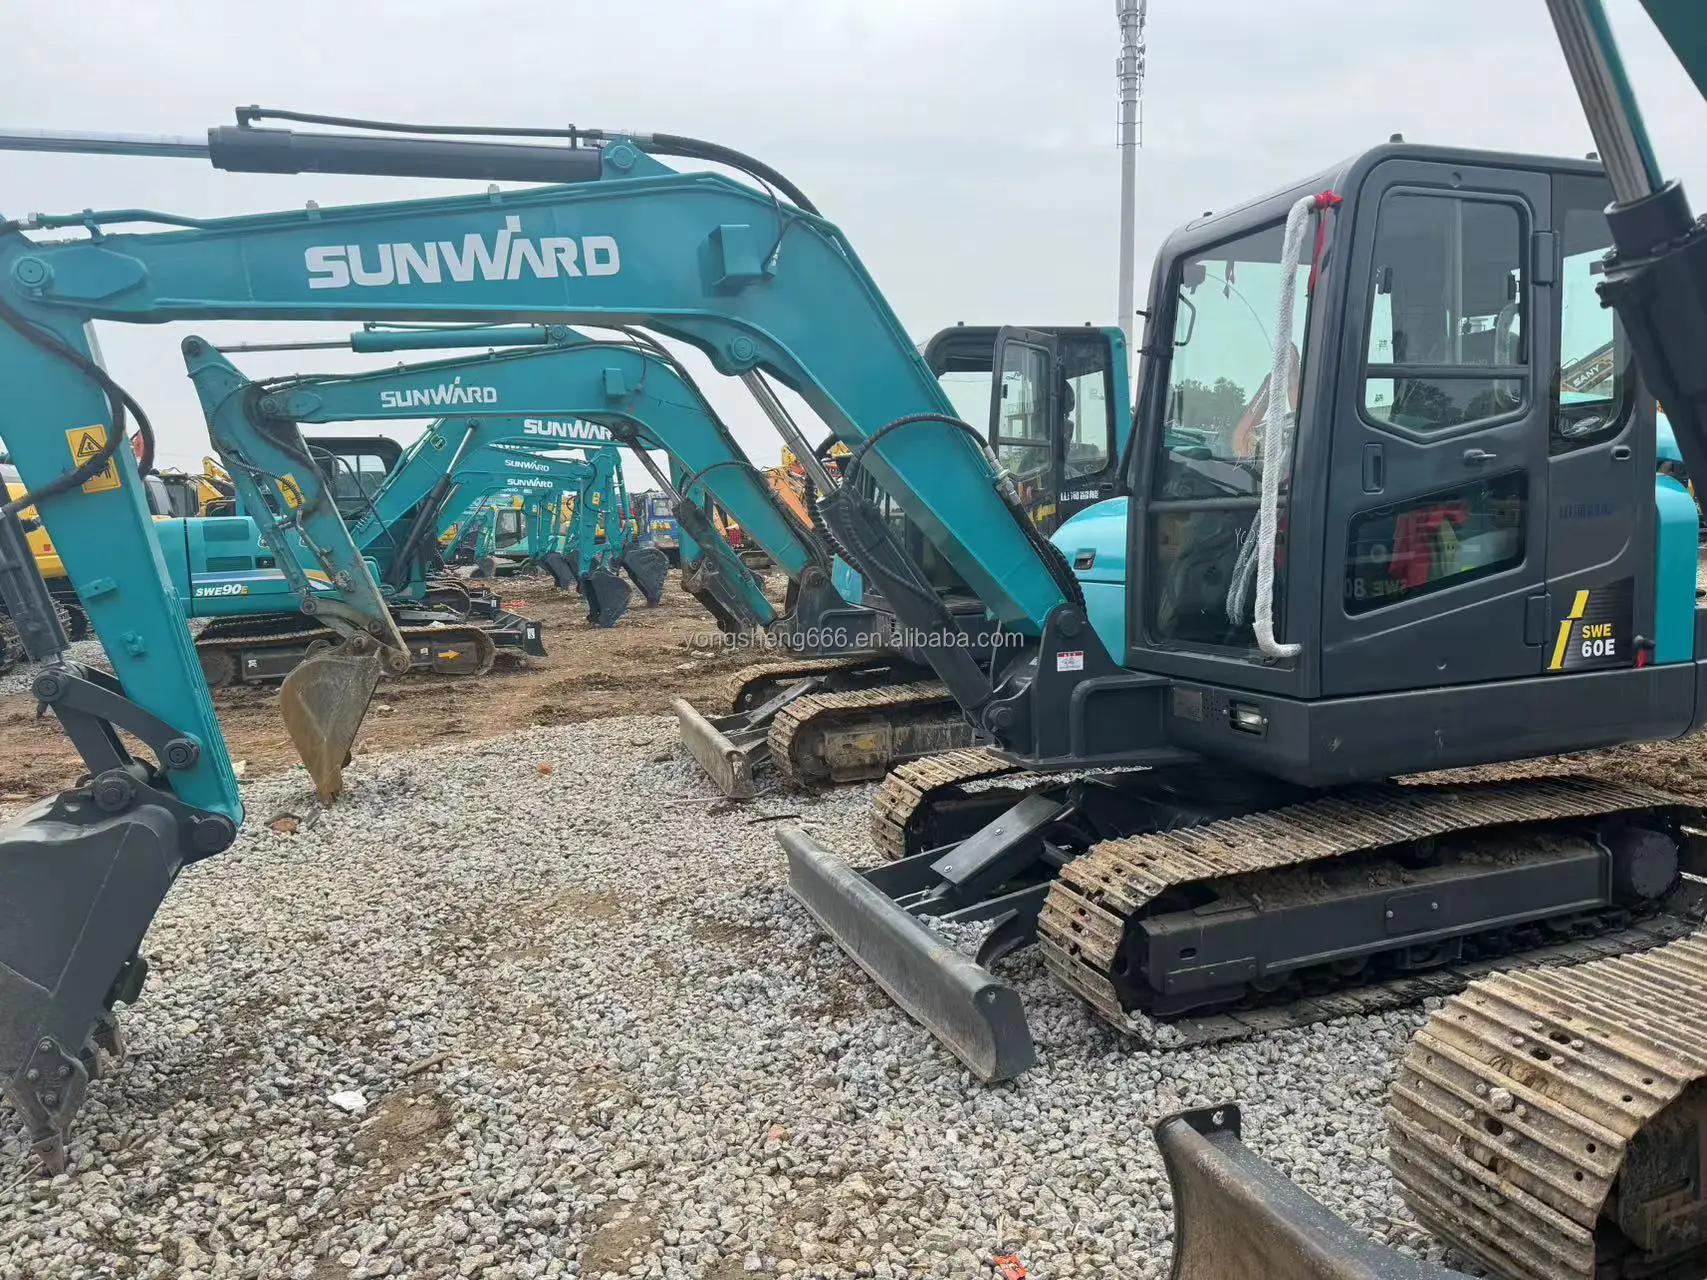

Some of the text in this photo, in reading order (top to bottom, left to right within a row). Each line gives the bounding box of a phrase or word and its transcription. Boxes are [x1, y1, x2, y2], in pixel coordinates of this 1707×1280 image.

[304, 215, 620, 289] SUNWARD
[1573, 364, 1599, 387] SANY
[380, 376, 497, 408] SUNWARD
[523, 419, 613, 440] SUNWAR
[504, 460, 550, 472] SUNWARD
[507, 477, 553, 488] SUNWARD
[195, 583, 249, 597] SWE90E
[1582, 623, 1612, 639] SWE
[1581, 638, 1616, 658] 60E
